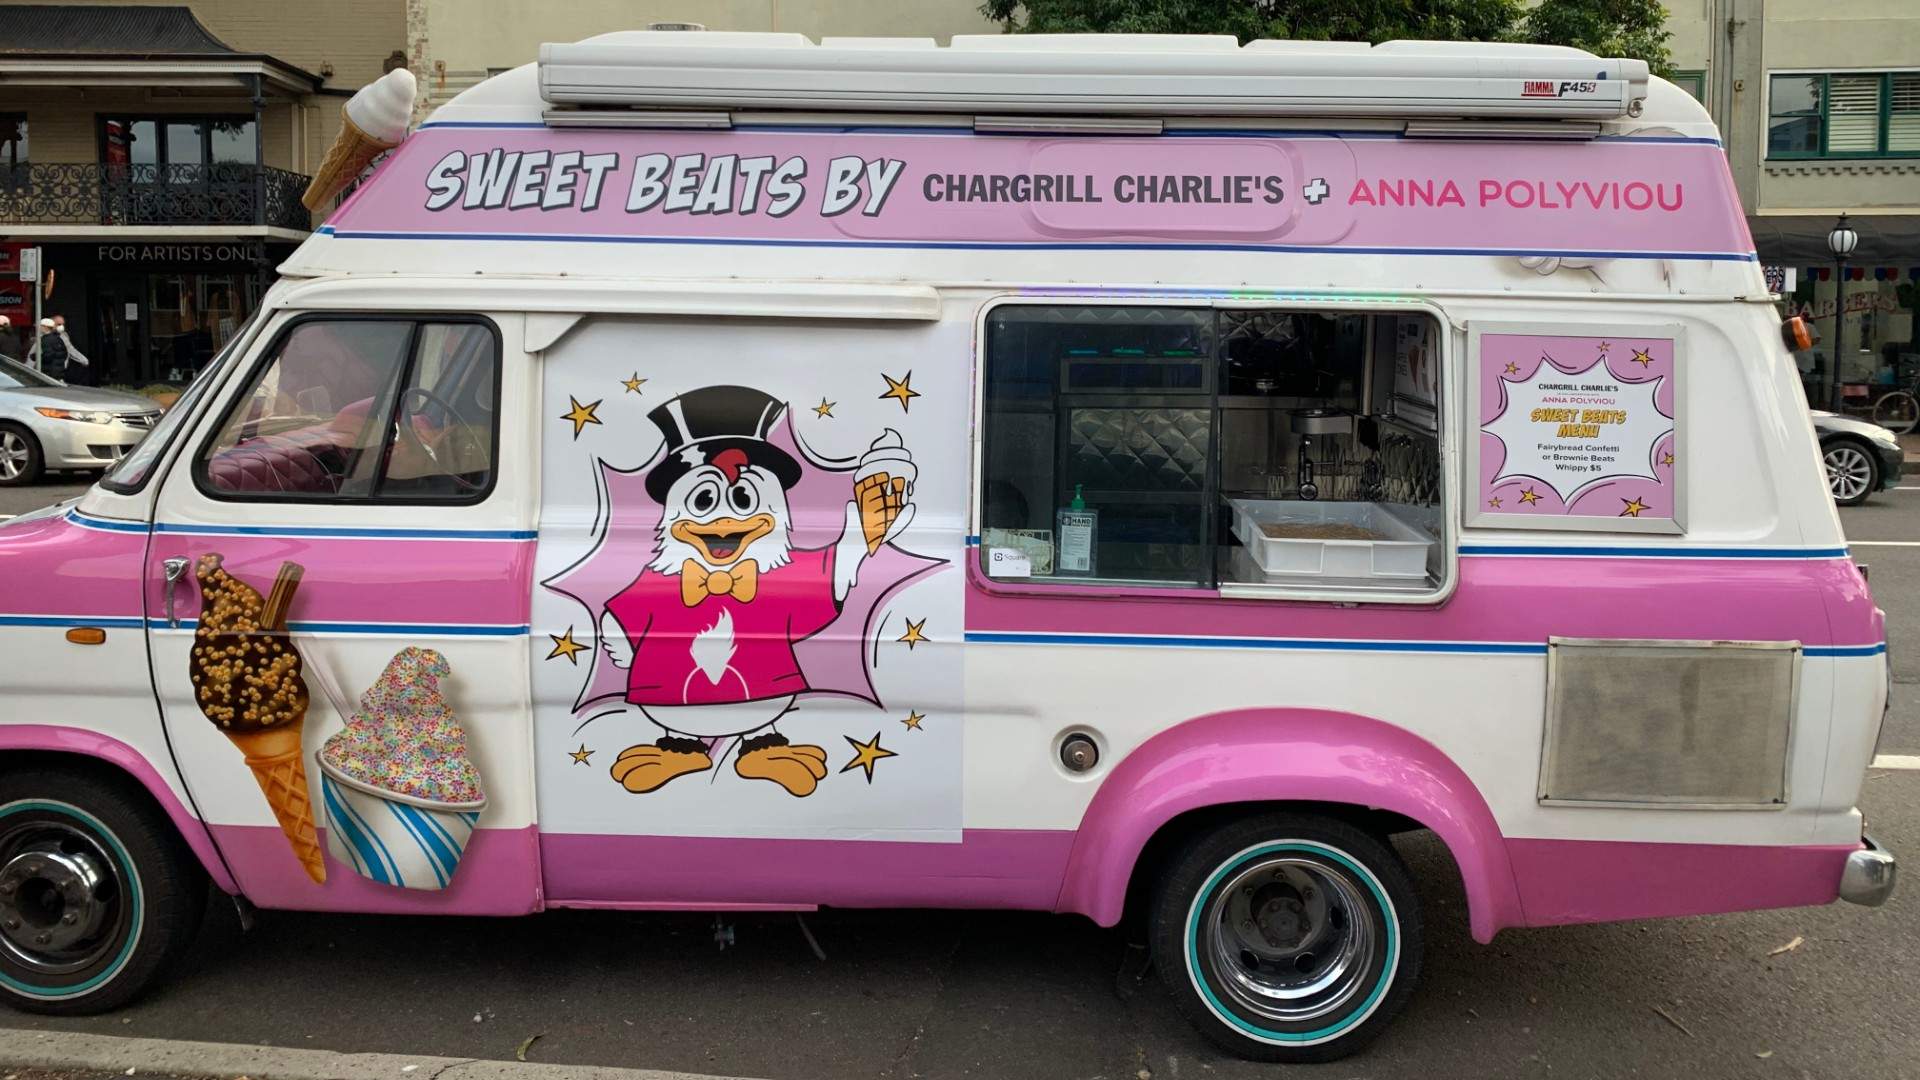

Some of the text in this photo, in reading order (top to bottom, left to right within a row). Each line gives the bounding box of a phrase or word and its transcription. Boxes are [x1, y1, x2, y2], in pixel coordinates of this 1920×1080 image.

[1523, 81, 1555, 94] FIAMMA
[425, 147, 619, 212] SWEET
[625, 152, 808, 218] BEATS
[820, 156, 906, 217] BY
[922, 173, 1102, 203] CHARGRILL
[1113, 174, 1285, 204] CHARLIE'S
[1347, 178, 1466, 207] ANNA
[1478, 179, 1684, 212] POLYVIOU
[98, 245, 257, 261] FOR ARTISTS ONL
[1538, 383, 1619, 392] CHARGRILL CHARLIE'S
[1570, 397, 1616, 405] POLYVIOU
[1530, 407, 1627, 424] SWEET BEATS
[1556, 424, 1600, 438] MENU
[1537, 443, 1620, 453] Fairybread Confetti
[1553, 453, 1589, 461] Brownie
[1590, 454, 1616, 462] Beats
[1555, 464, 1602, 473] Whippy $5
